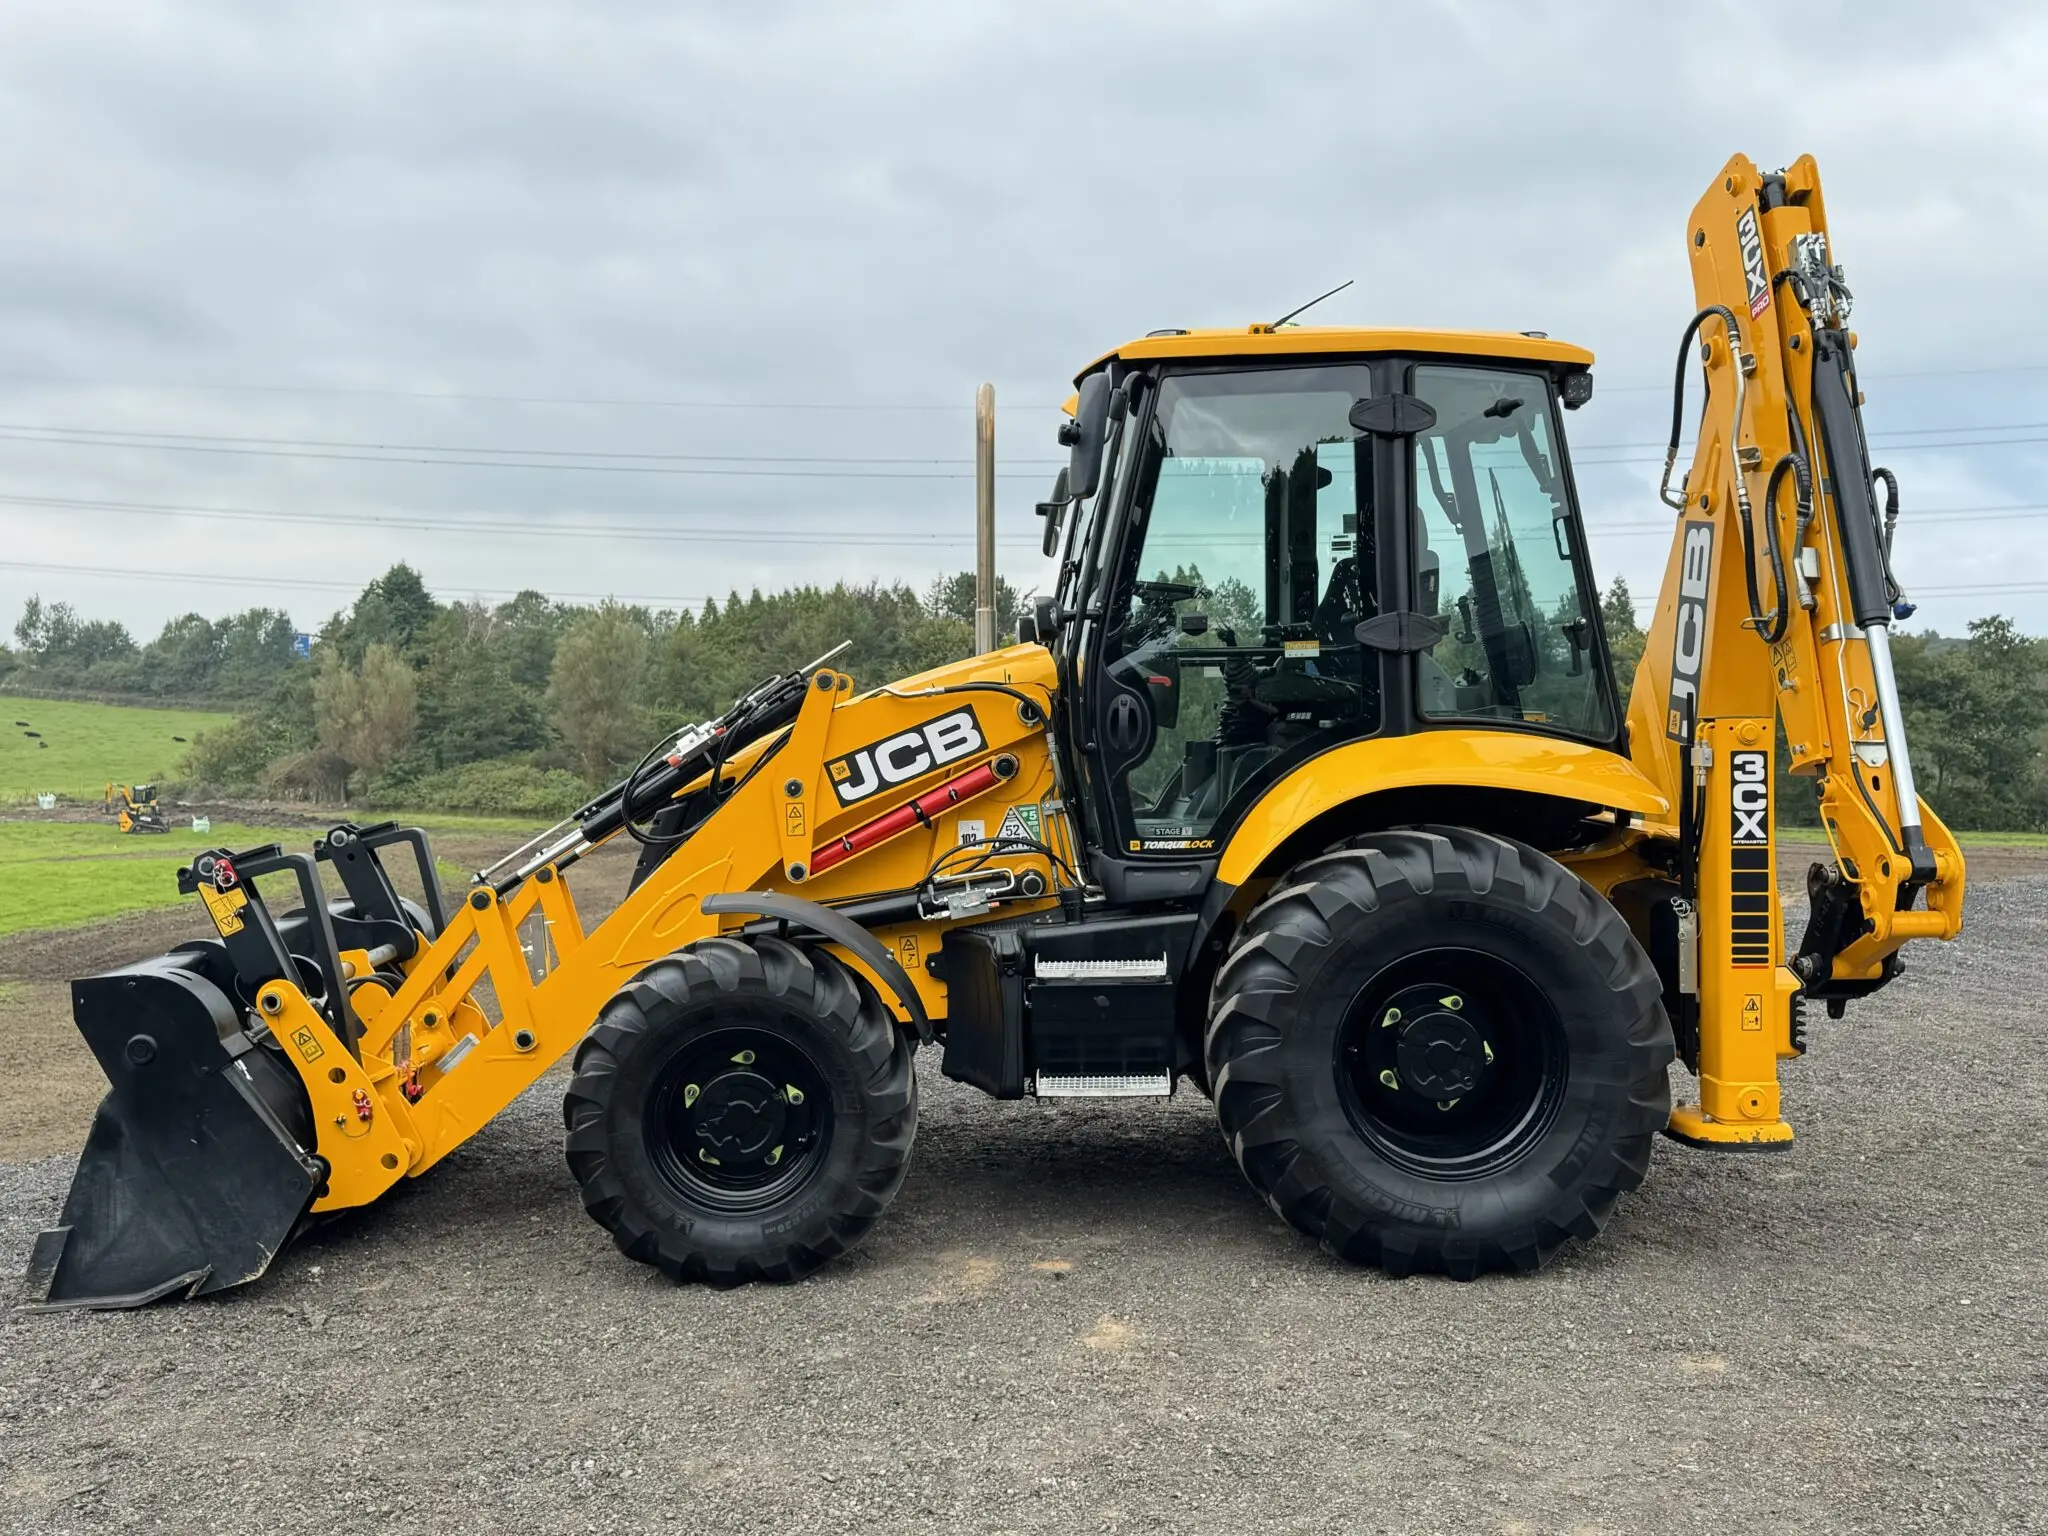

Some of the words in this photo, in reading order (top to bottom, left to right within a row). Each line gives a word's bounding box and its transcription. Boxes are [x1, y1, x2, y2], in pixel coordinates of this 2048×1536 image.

[1738, 210, 1767, 300] 3CX
[1751, 294, 1769, 319] PRO
[1672, 527, 1711, 738] JCB
[838, 712, 982, 801] JCB
[1029, 811, 1037, 820] 5
[1732, 753, 1768, 839] 3CX
[1005, 825, 1020, 837] 52
[1143, 840, 1215, 850] TORQUELOCK
